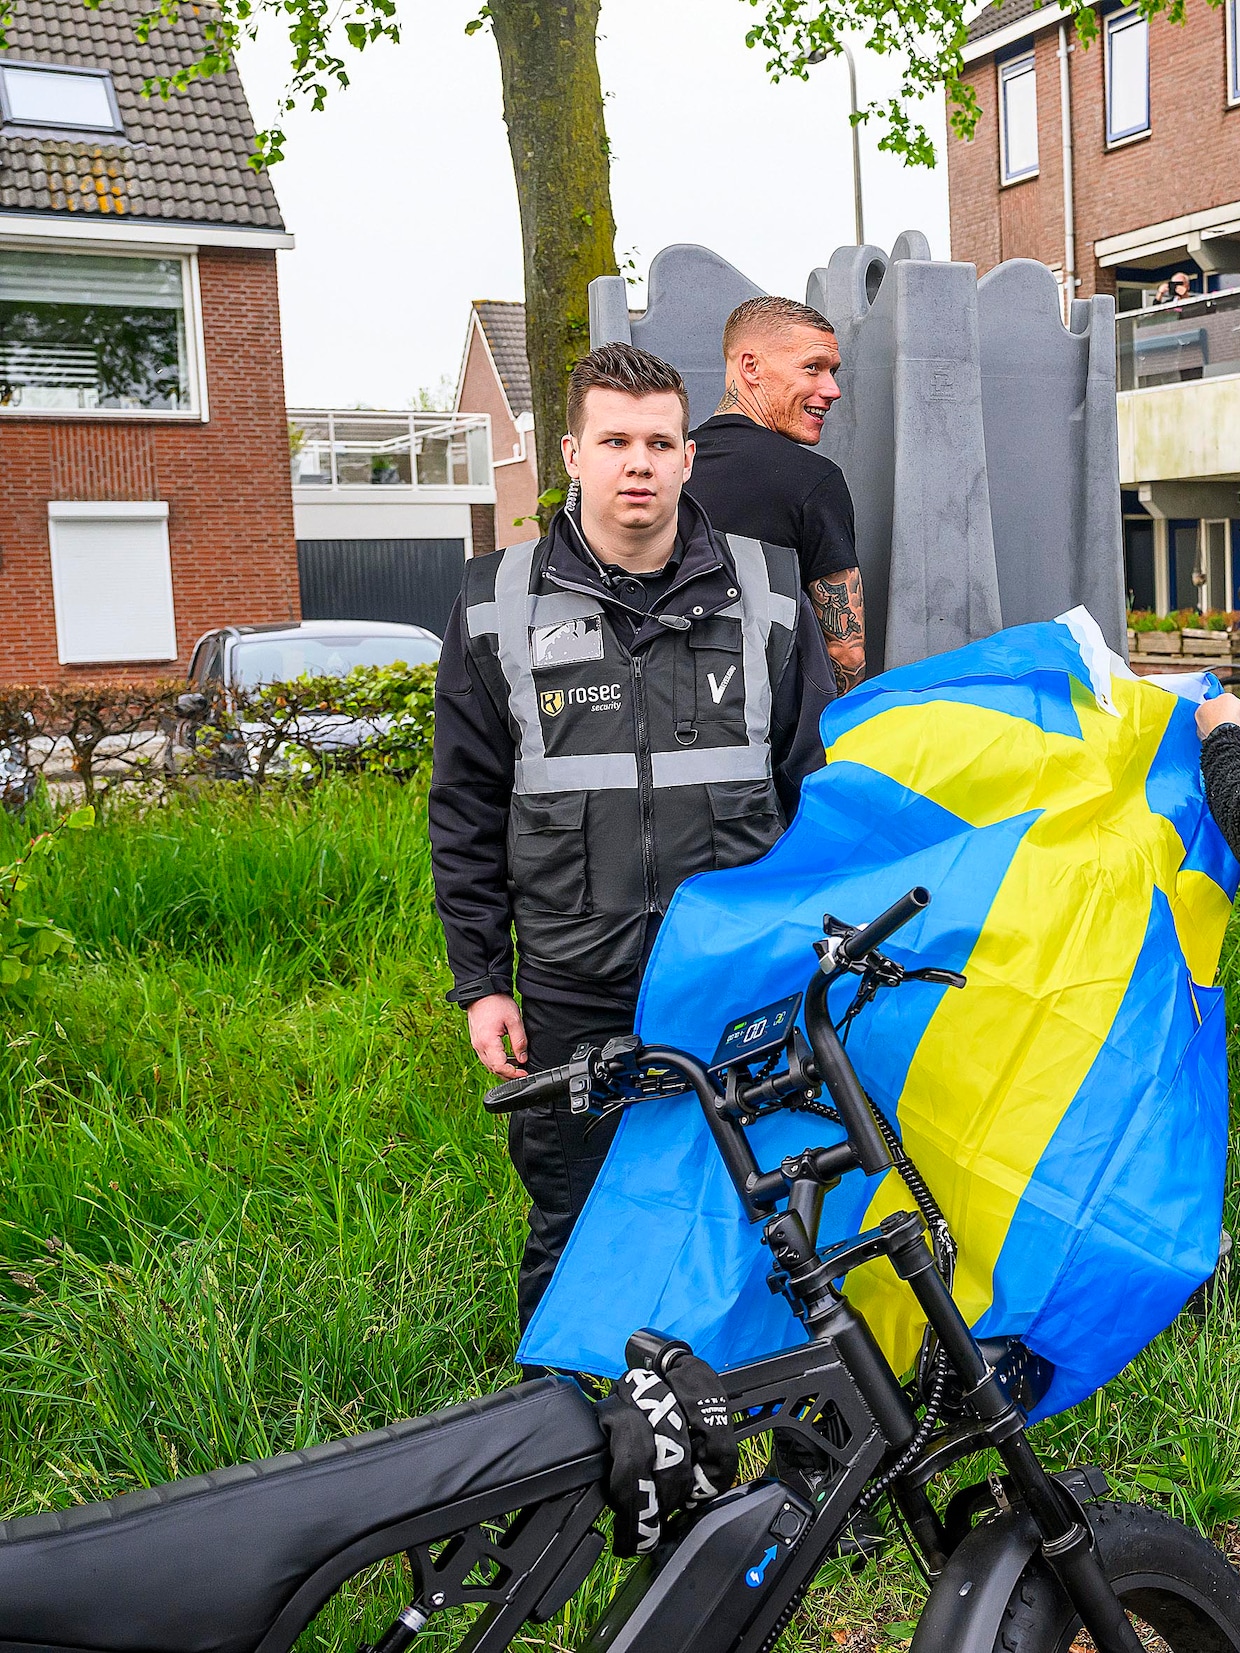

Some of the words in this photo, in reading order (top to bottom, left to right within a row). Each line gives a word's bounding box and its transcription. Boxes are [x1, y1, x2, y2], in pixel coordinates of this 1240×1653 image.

[568, 683, 621, 705] rosec
[591, 701, 622, 712] security
[624, 1368, 685, 1471] AXA
